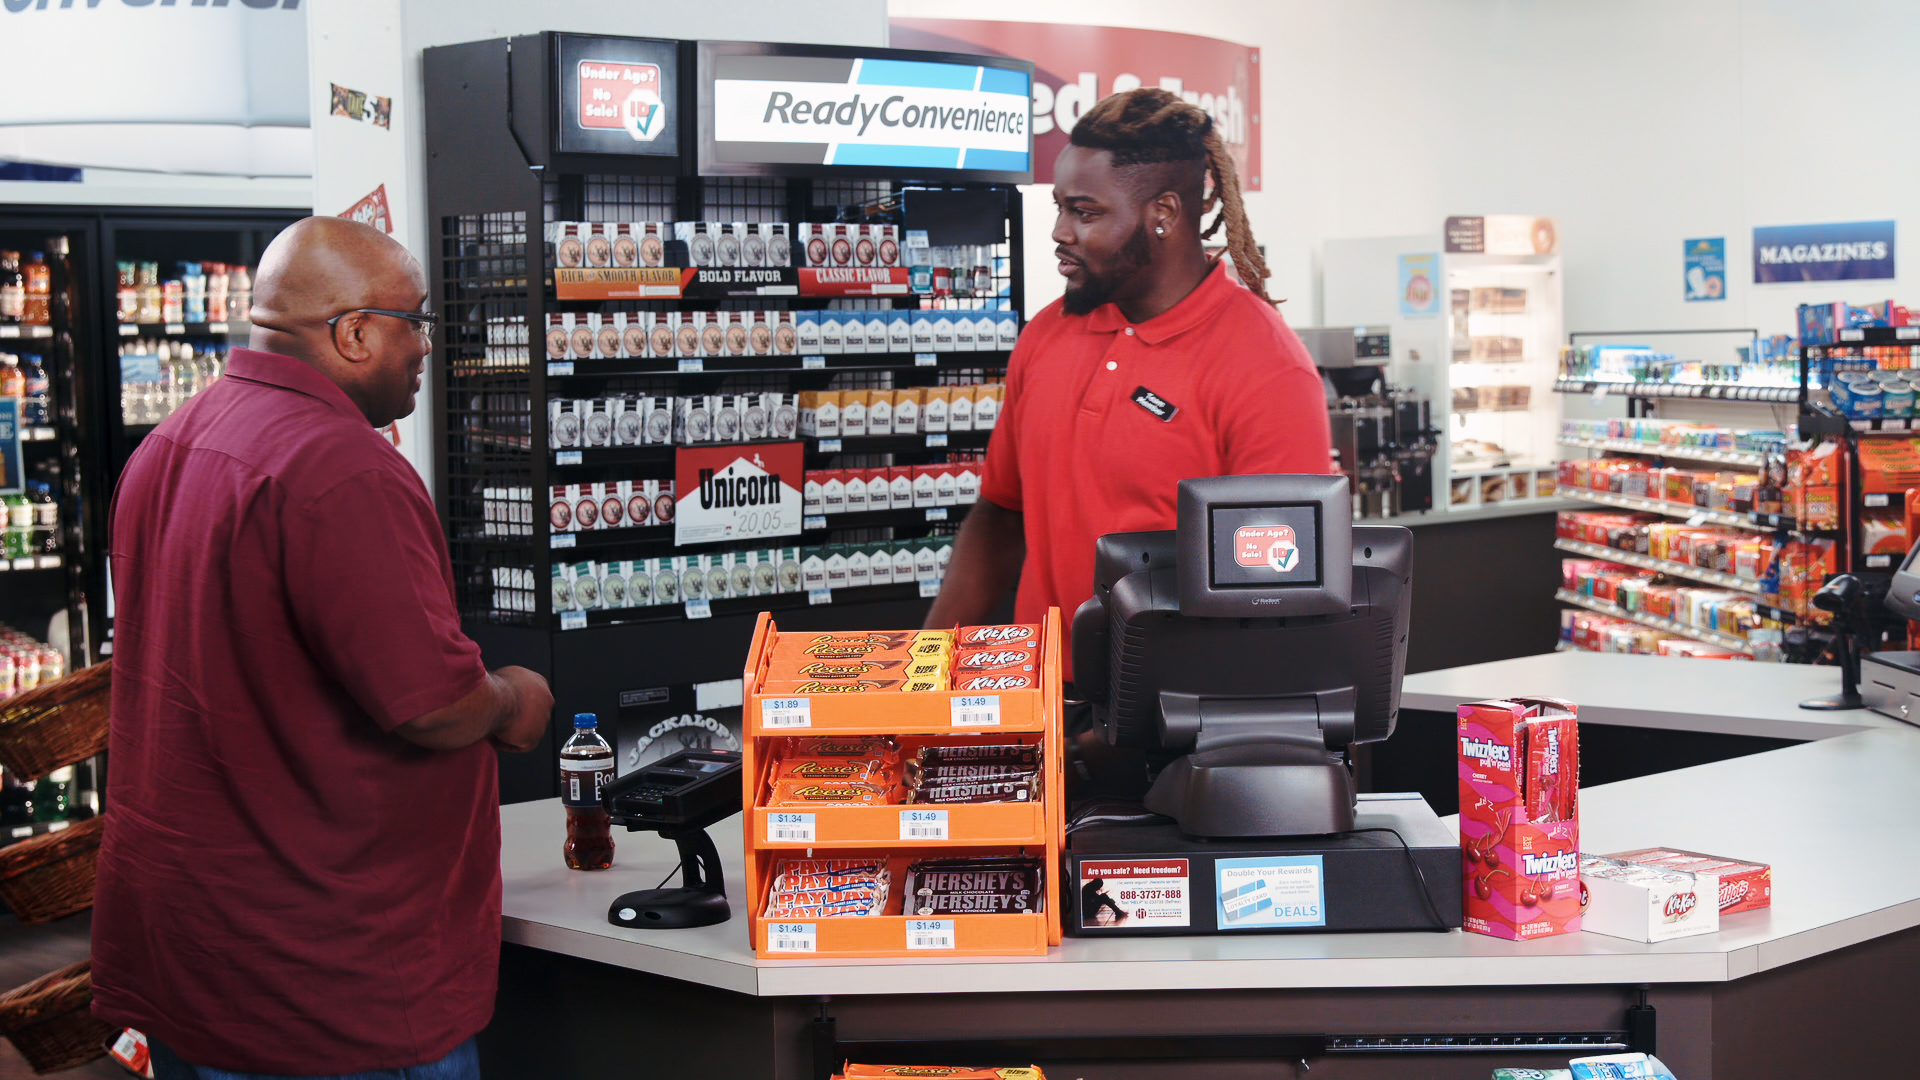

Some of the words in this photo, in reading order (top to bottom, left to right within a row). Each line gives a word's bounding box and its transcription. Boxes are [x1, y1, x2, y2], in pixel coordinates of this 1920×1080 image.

[581, 66, 619, 81] Under
[623, 68, 656, 85] Age?
[593, 88, 611, 101] No
[586, 104, 618, 118] Sale!
[630, 101, 651, 117] ID
[763, 90, 1024, 137] ReadyConvenience
[1760, 241, 1888, 264] MAGAZINES
[561, 270, 584, 283] RICH
[598, 270, 637, 283] SMOOTH
[640, 270, 675, 283] FLAVOR
[699, 270, 731, 283] BOLD
[734, 270, 782, 283] FLAVOR
[816, 268, 856, 284] CLASSIC
[857, 268, 891, 284] FLAVOR
[699, 467, 780, 510] Unicorn
[1267, 529, 1289, 538] Age?
[1272, 548, 1288, 557] ID
[803, 643, 876, 655] Reese's
[798, 662, 871, 674] Reese's
[793, 682, 868, 694] Reese's
[774, 700, 798, 709] $1.89
[961, 697, 986, 707] $1.49
[1460, 737, 1510, 761] Twizzlers
[792, 761, 863, 773] Reese's
[794, 785, 865, 796] Reese's
[930, 783, 1015, 799] HERSHEY'S
[778, 814, 802, 823] $1.34
[912, 812, 937, 821] $1.49
[1522, 850, 1577, 875] Twizzlers
[1113, 867, 1130, 875] safe?
[1151, 866, 1181, 874] freedom?
[1277, 867, 1312, 875] Rewards
[924, 872, 1025, 891] HERSHEY'S
[1120, 890, 1181, 899] 888-3737-888
[924, 895, 1028, 909] HERSHEY'S
[1227, 898, 1251, 911] LOYALTY
[1251, 892, 1268, 902] CARD
[1274, 905, 1318, 917] DEALS
[778, 924, 803, 933] $1.49
[916, 921, 941, 930] $1.49
